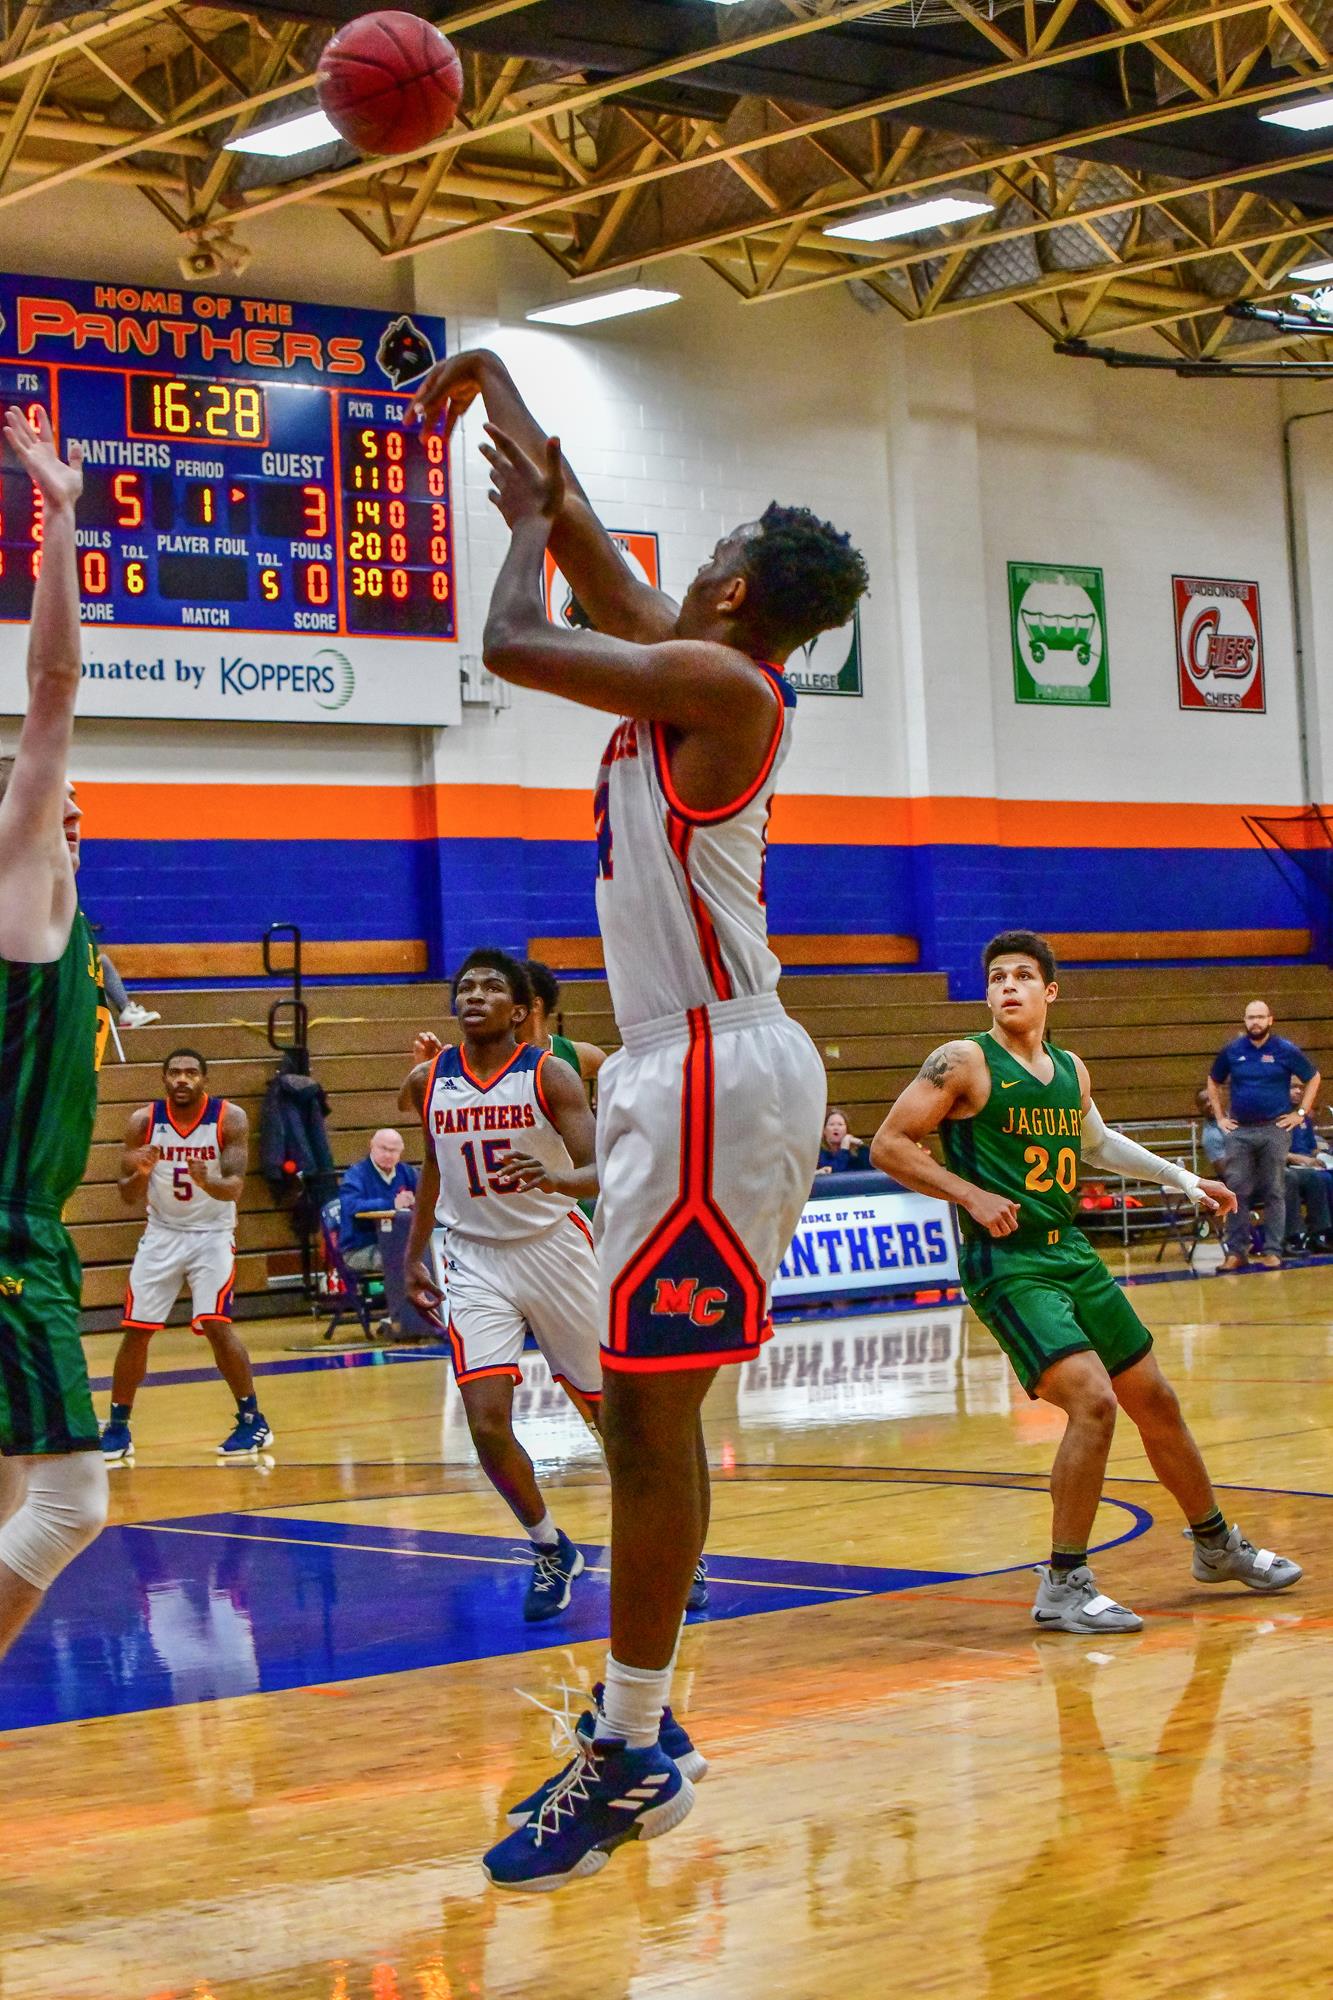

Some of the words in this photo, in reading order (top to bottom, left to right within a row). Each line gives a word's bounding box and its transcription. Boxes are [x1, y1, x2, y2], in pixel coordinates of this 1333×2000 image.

[95, 286, 183, 315] HOME
[193, 296, 232, 319] OF
[240, 301, 292, 326] THE
[17, 297, 366, 374] PANTHERS
[17, 373, 38, 391] PTS
[153, 382, 261, 438] 16:28
[349, 402, 373, 418] PLYR
[385, 404, 403, 421] FLS
[362, 430, 377, 458] 5
[387, 432, 402, 460] 0
[428, 435, 443, 463] 0
[176, 459, 224, 479] PERIOD
[262, 451, 325, 479] GUEST
[355, 466, 379, 489] 11
[388, 465, 403, 493] 0
[428, 468, 444, 496] 0
[114, 474, 141, 526] 5
[203, 488, 212, 522] 1
[303, 487, 327, 537] 3
[357, 501, 380, 525] 14
[389, 501, 404, 528] 0
[432, 504, 445, 531] 3
[76, 531, 112, 549] OULS
[158, 535, 209, 554] PLAYER
[215, 538, 249, 557] FOUL
[290, 542, 333, 561] FOULS
[350, 532, 381, 560] 20
[391, 533, 406, 562] 0
[431, 536, 446, 564] 0
[84, 552, 106, 594] 0
[126, 563, 144, 594] 6
[262, 570, 279, 600] 5
[307, 564, 329, 604] 0
[353, 568, 382, 596] 30
[392, 569, 407, 598] 0
[433, 571, 448, 599] 0
[80, 603, 115, 621] CORE
[181, 607, 230, 626] MATCH
[294, 612, 337, 631] SCORE
[80, 659, 165, 681] onated
[175, 660, 206, 688] by
[221, 657, 335, 695] KOPPERS
[1205, 692, 1241, 706] CHIEFS
[434, 1103, 536, 1134] PANTHERS
[461, 1138, 521, 1198] 15
[1024, 1145, 1077, 1193] 20
[173, 1168, 193, 1201] 5
[801, 1213, 831, 1224] HOME
[837, 1211, 848, 1221] OF
[853, 1210, 876, 1219] THE
[651, 1278, 728, 1326] MC
